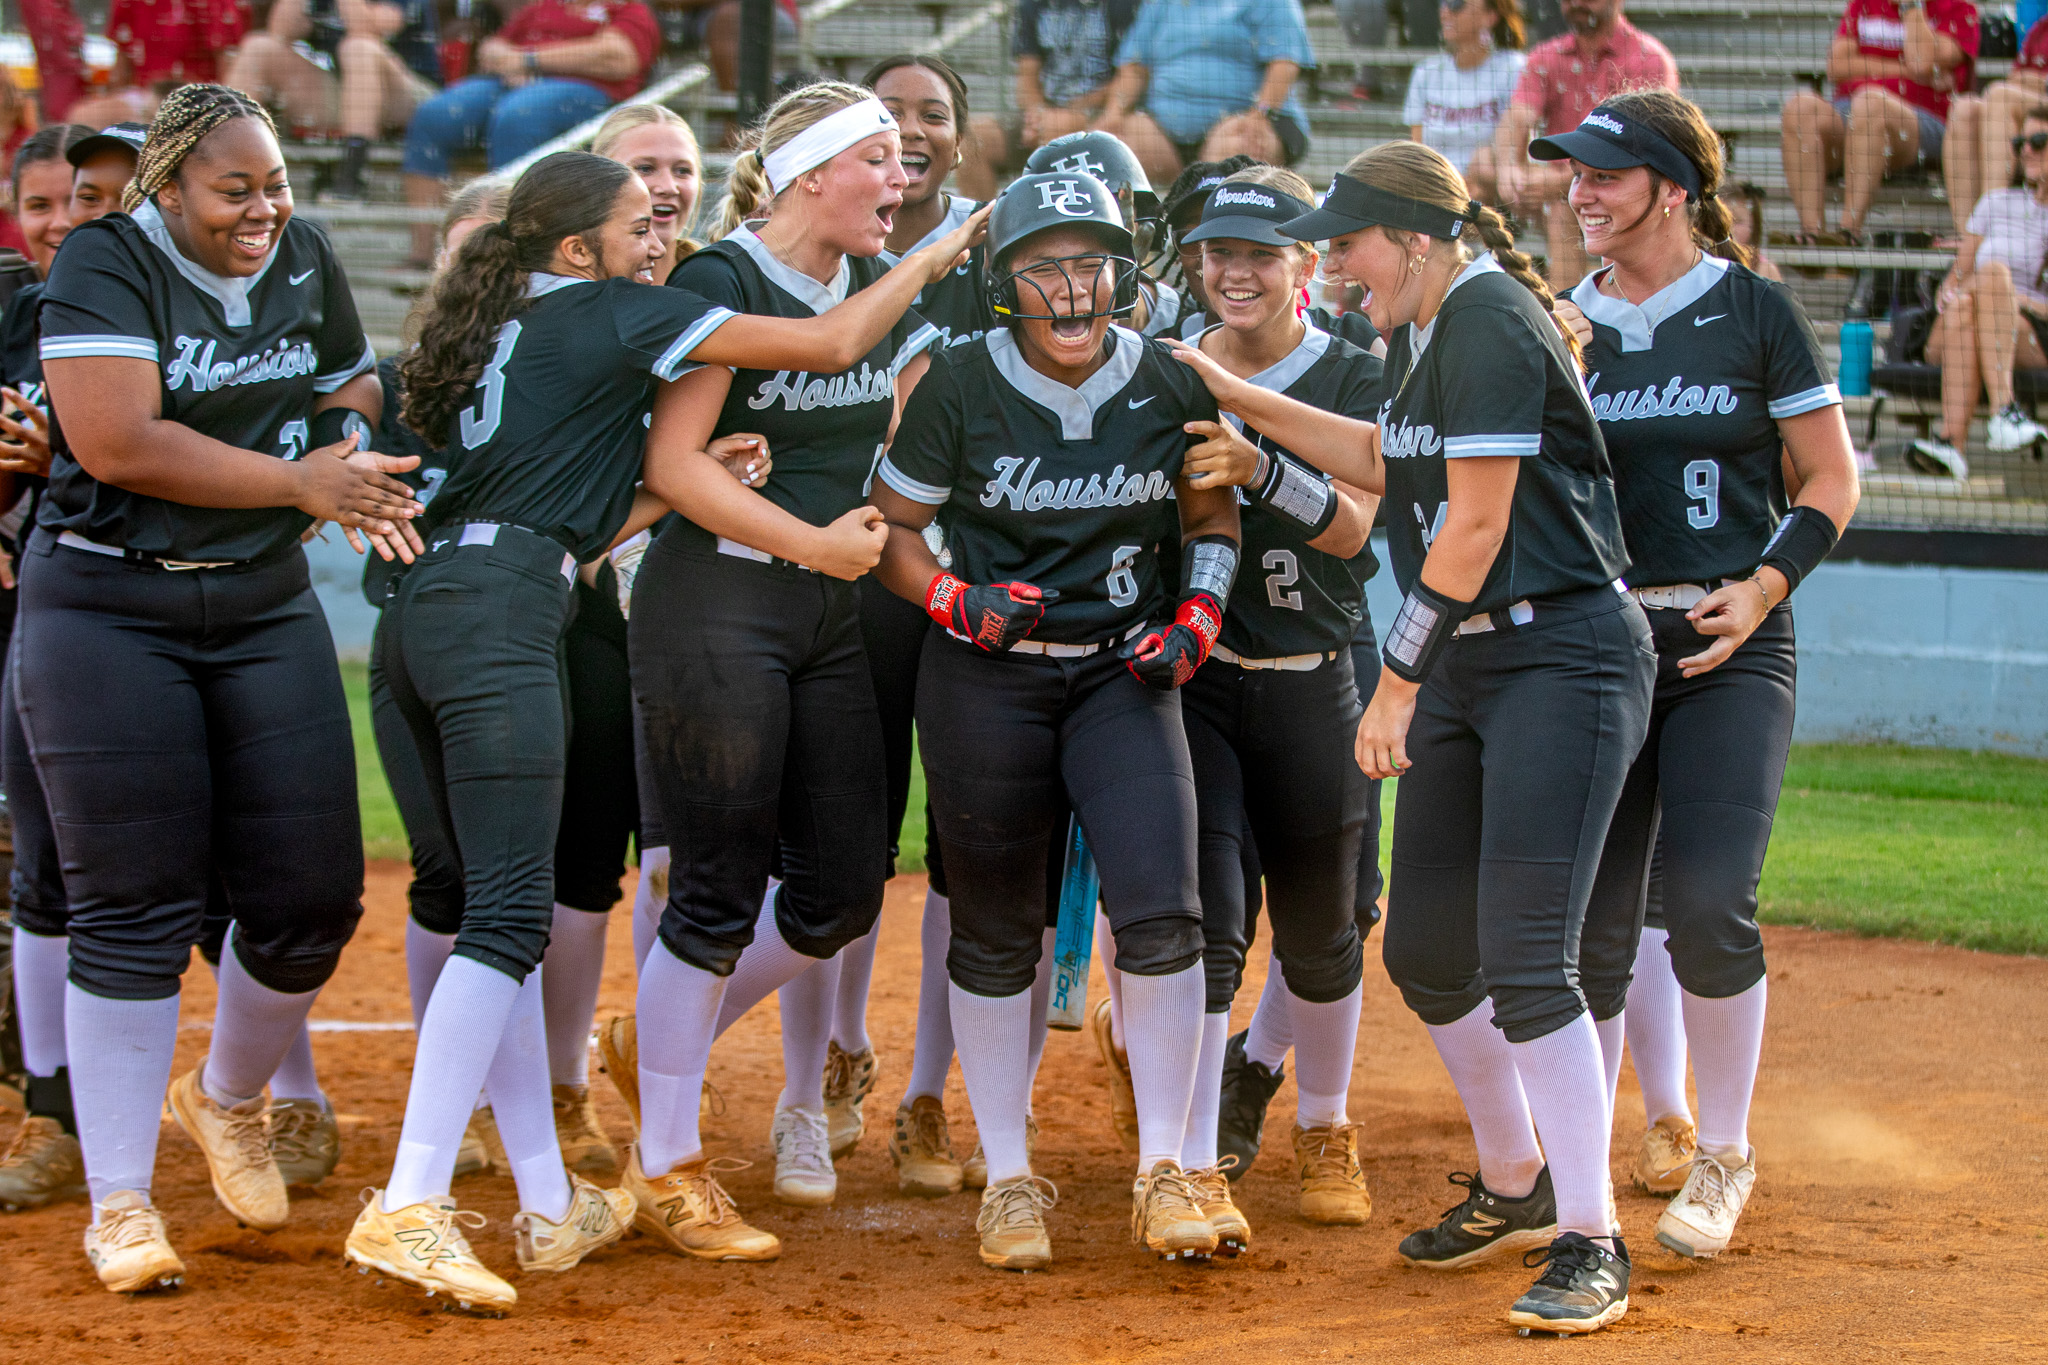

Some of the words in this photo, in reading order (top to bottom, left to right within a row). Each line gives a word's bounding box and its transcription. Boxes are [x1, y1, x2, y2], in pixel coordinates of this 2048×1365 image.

[1034, 180, 1095, 217] HC
[1214, 187, 1276, 209] Houston
[166, 335, 319, 392] Houston
[459, 319, 523, 451] 3
[1585, 372, 1738, 422] ouston
[979, 456, 1170, 512] Houston
[1684, 459, 1719, 530] 9
[1262, 549, 1303, 611] 2
